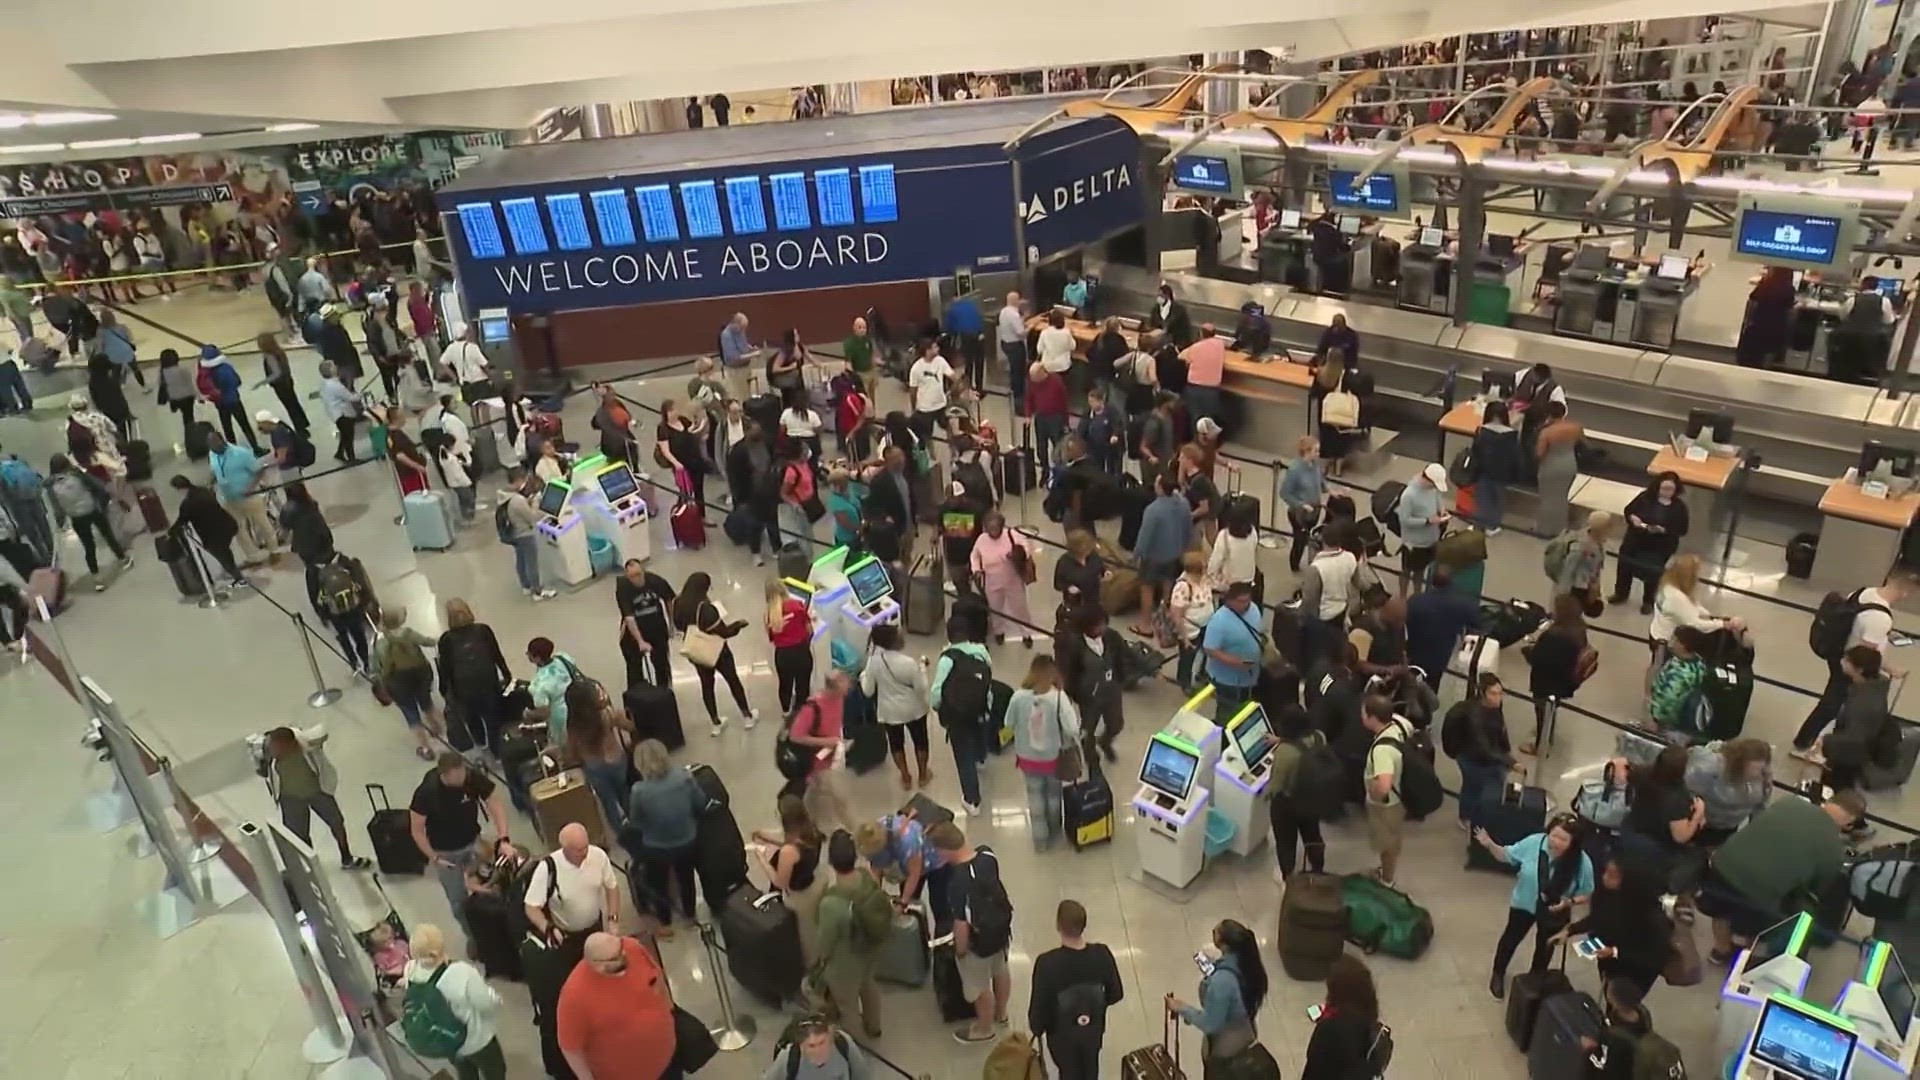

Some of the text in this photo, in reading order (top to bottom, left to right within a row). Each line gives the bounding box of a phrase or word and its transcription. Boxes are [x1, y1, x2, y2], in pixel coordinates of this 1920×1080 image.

[298, 143, 408, 170] EXPLORE
[18, 166, 132, 191] SHOP
[1053, 164, 1132, 212] DELTA
[494, 232, 889, 296] WELCOME ABOARD
